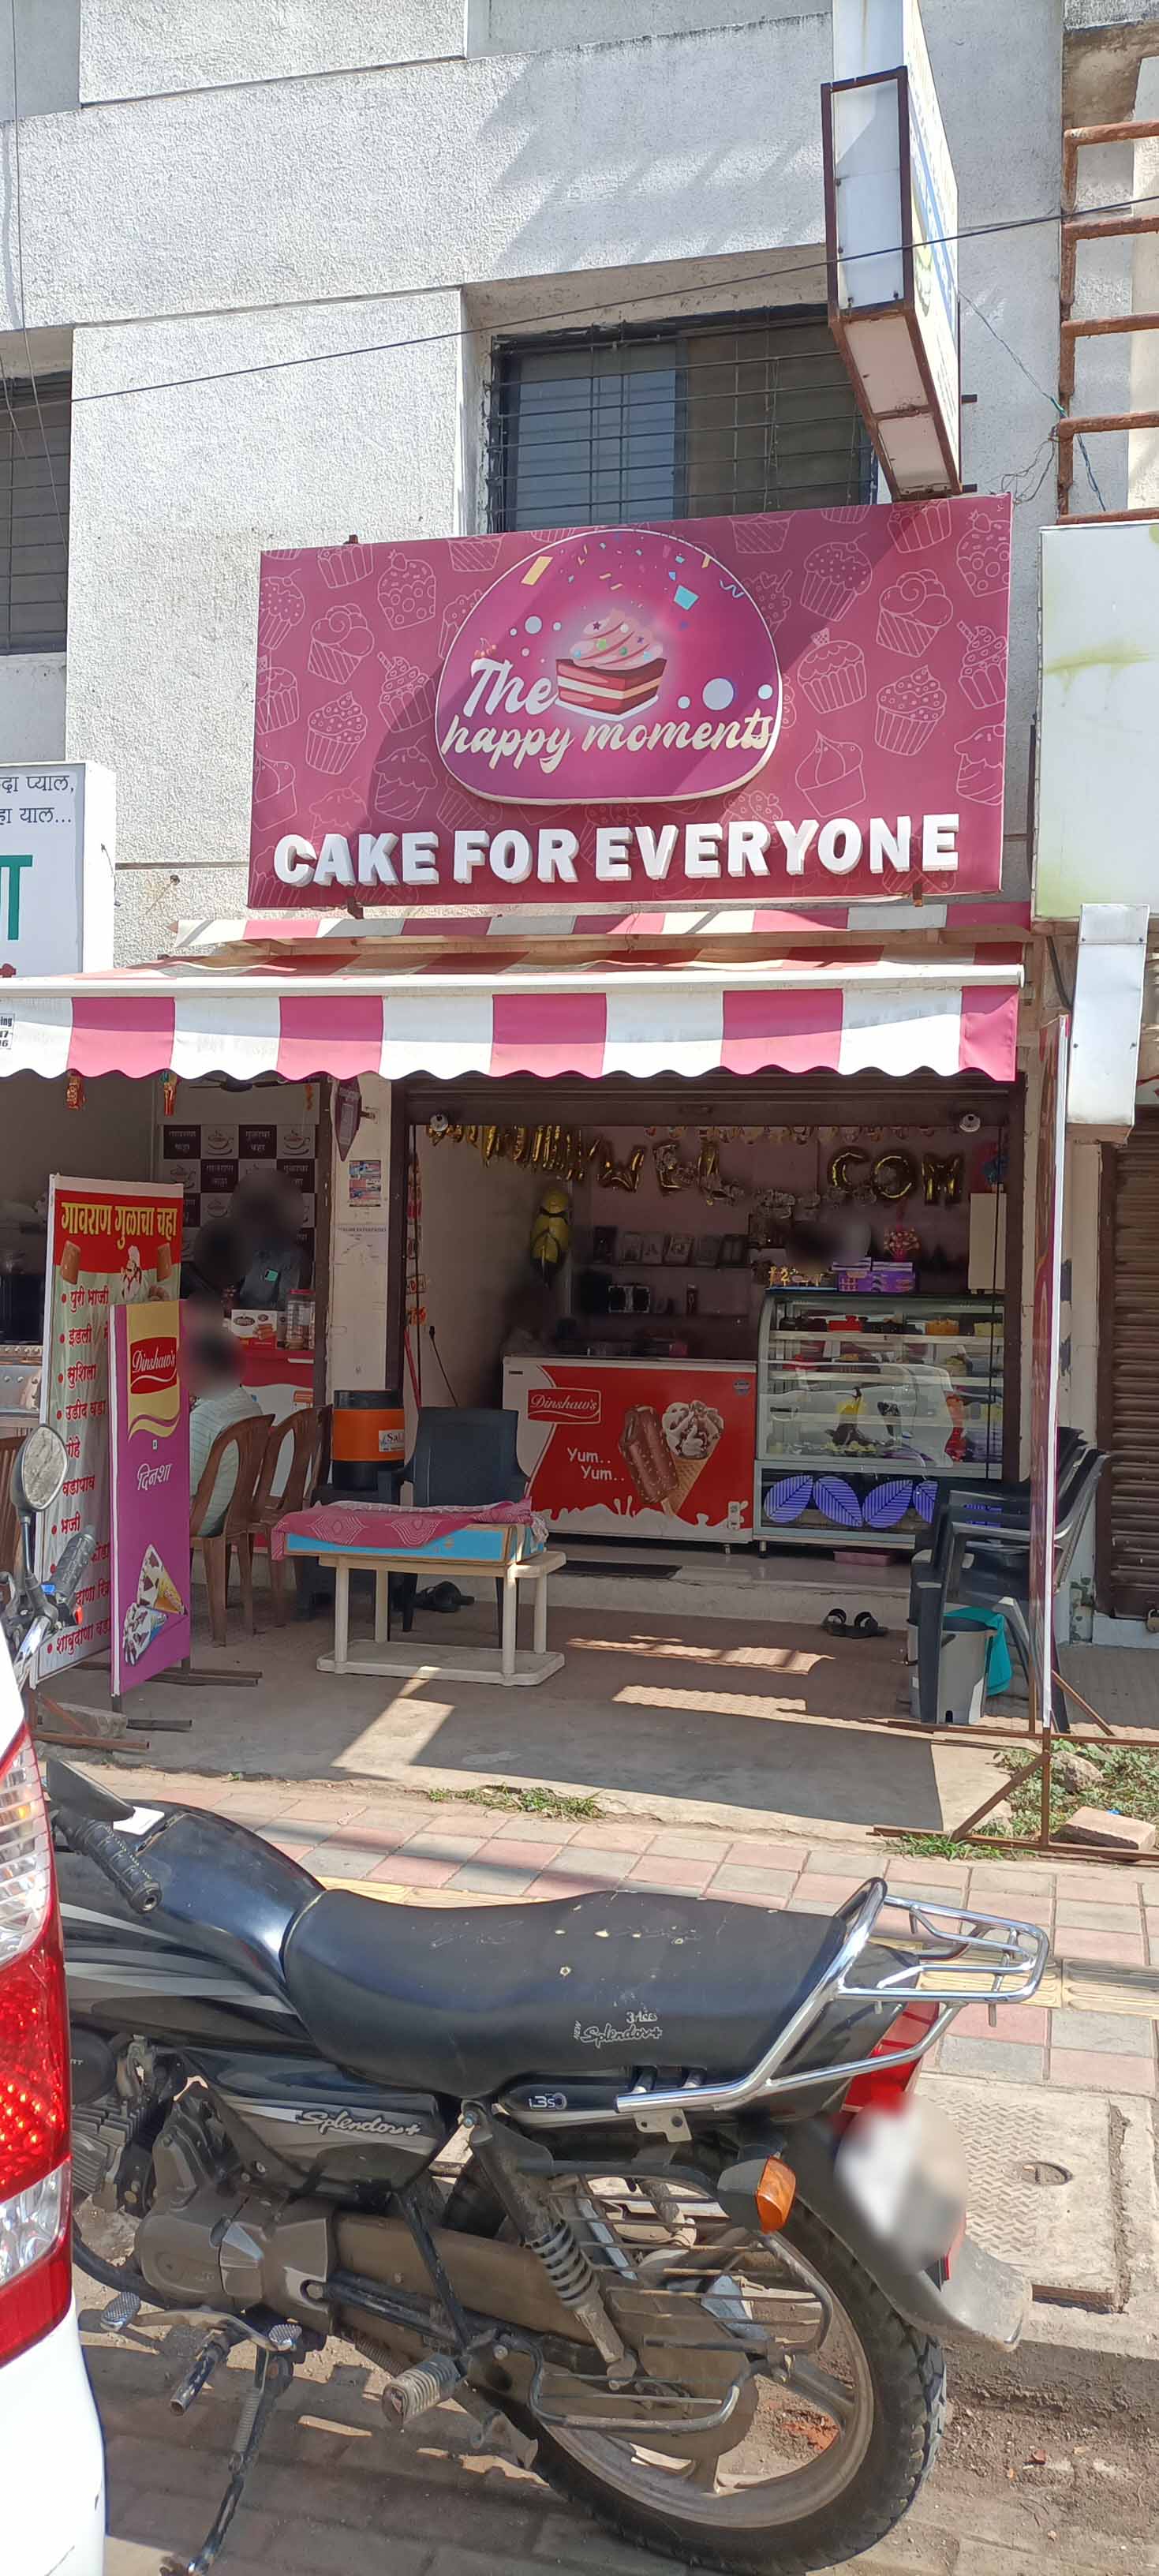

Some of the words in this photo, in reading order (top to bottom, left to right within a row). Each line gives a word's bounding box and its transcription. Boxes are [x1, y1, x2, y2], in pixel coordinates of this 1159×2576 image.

[462, 657, 557, 717] The
[442, 714, 575, 774] happy
[581, 708, 773, 752] moments
[273, 831, 440, 888] CAKE
[454, 828, 580, 885] FOR
[595, 813, 960, 882] EVERYONE
[114, 1205, 155, 1251] गुळाचा
[157, 1207, 178, 1242] चहा
[132, 1346, 176, 1373] Dinshaw's
[65, 1398, 88, 1421] उडीद
[529, 1394, 598, 1410] Dinshaw's
[136, 1462, 173, 1491] दिनशा
